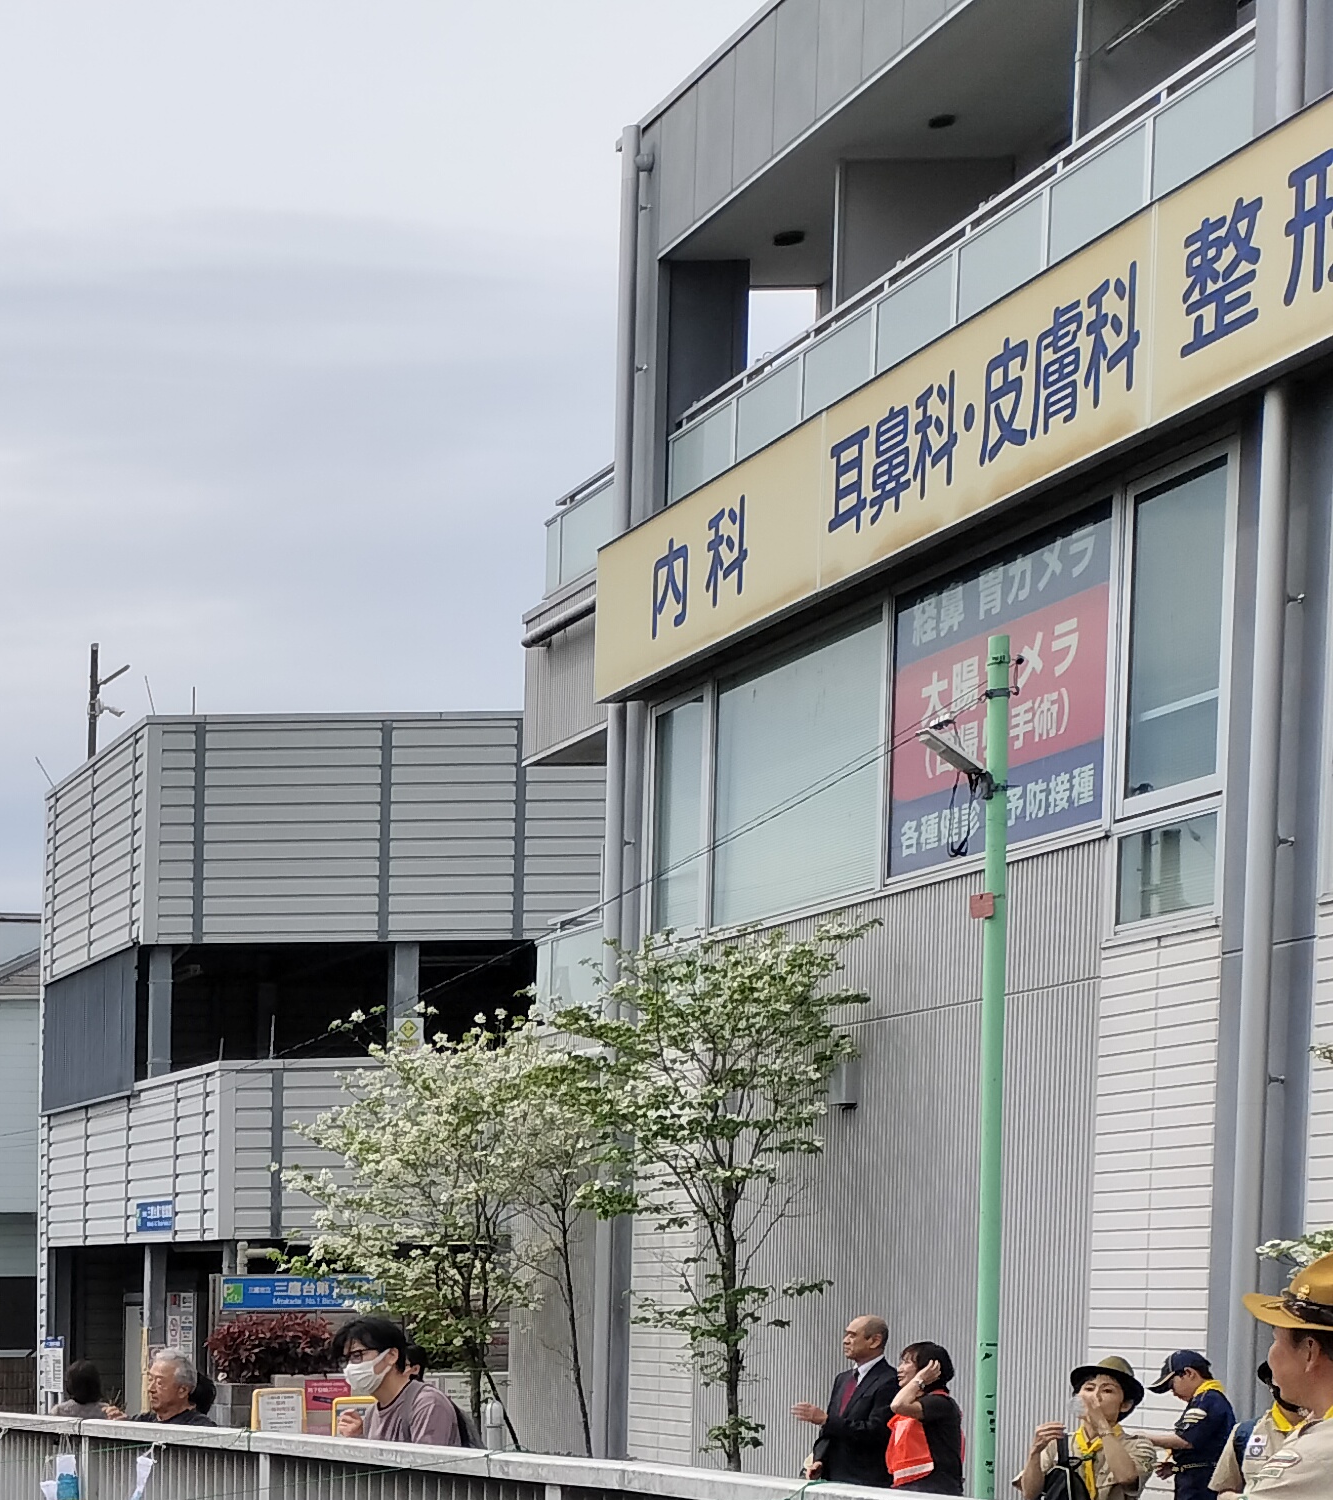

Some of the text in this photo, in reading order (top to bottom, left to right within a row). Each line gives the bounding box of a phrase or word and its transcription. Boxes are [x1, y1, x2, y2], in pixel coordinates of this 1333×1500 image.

[828, 260, 1141, 535] 耳鼻科・皮膚科
[651, 494, 749, 641] 内科
[921, 617, 1079, 725] 大腸メラ
